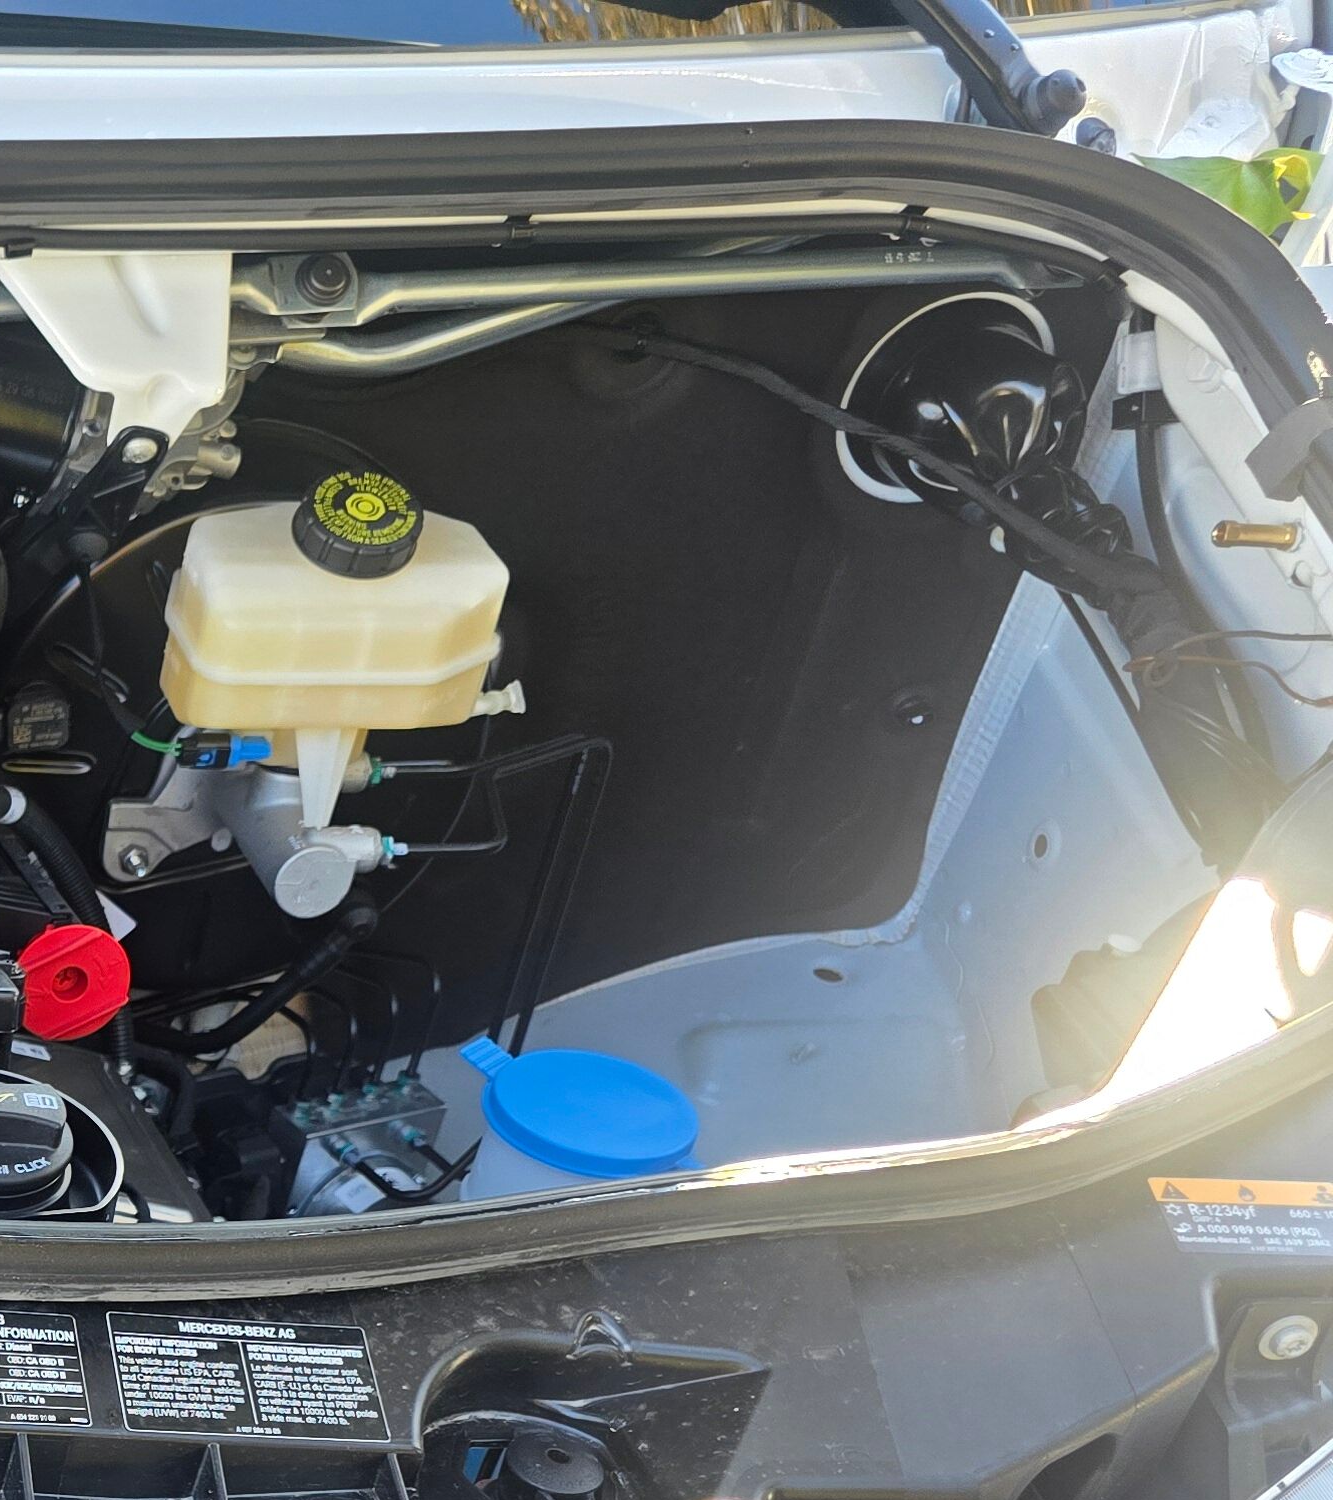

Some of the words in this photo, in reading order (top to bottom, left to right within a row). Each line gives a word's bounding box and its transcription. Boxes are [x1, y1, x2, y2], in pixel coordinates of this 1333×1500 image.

[13, 1156, 52, 1174] CLICK
[1187, 1203, 1257, 1220] R-1234yf
[1289, 1209, 1311, 1219] 660
[1197, 1224, 1207, 1233] A
[1207, 1224, 1230, 1234] 000
[1232, 1225, 1253, 1235] 989
[1255, 1226, 1271, 1235] 06
[1273, 1226, 1289, 1236] 06
[1290, 1227, 1321, 1239] (PAG)
[178, 1321, 277, 1338] MERCEDES-BENZ
[278, 1327, 296, 1340] AG
